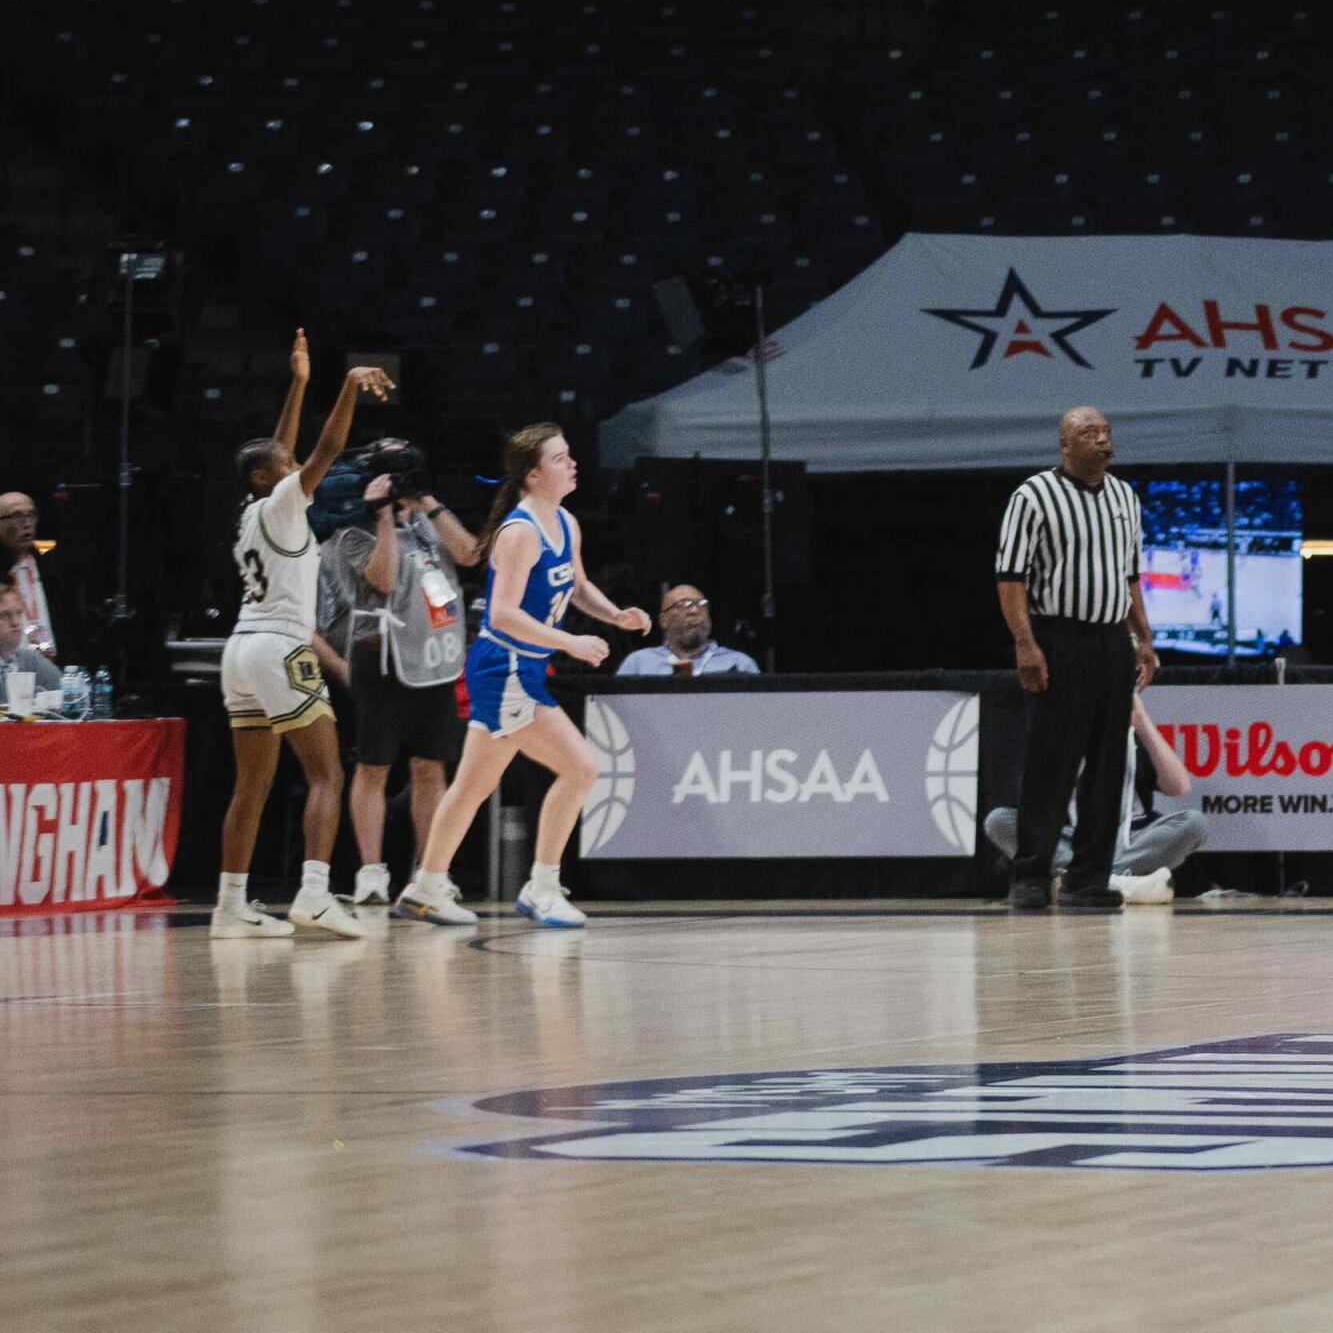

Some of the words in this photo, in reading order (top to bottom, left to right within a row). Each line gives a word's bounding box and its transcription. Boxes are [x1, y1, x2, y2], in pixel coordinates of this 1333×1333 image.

[1134, 357, 1204, 379] TV
[672, 748, 890, 804] AHSAA
[1202, 795, 1273, 815] MORE
